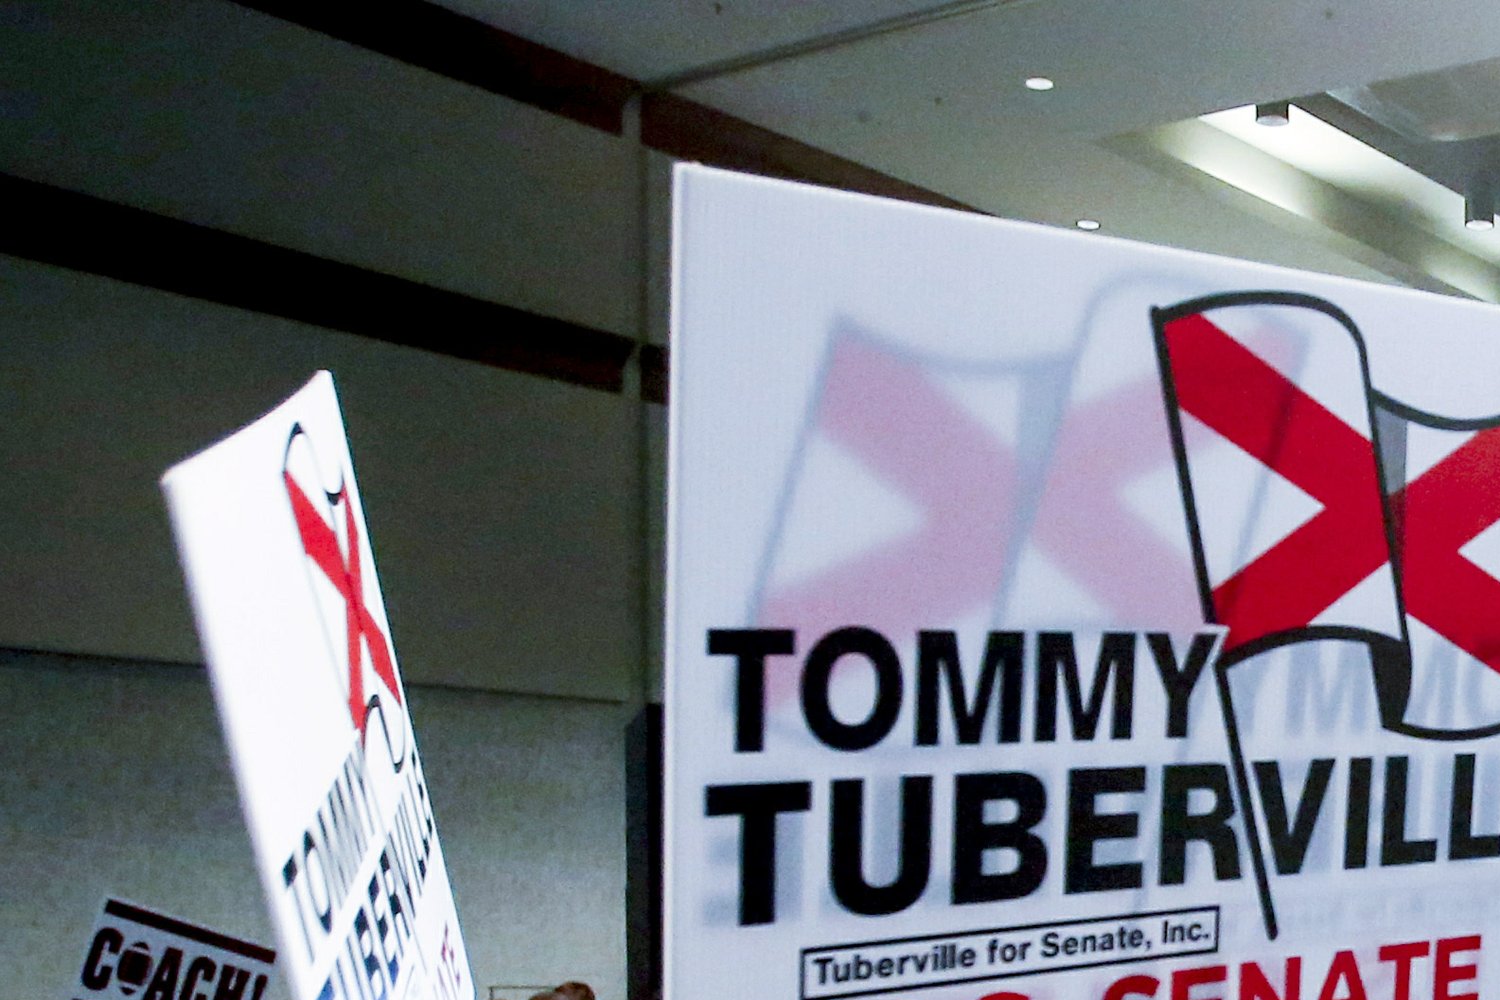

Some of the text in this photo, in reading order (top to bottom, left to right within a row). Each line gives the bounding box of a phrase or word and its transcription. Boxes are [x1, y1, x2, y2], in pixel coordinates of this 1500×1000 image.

[706, 626, 1216, 752] TOMMY
[813, 919, 1210, 986] Tuberville for Senate, Inc.
